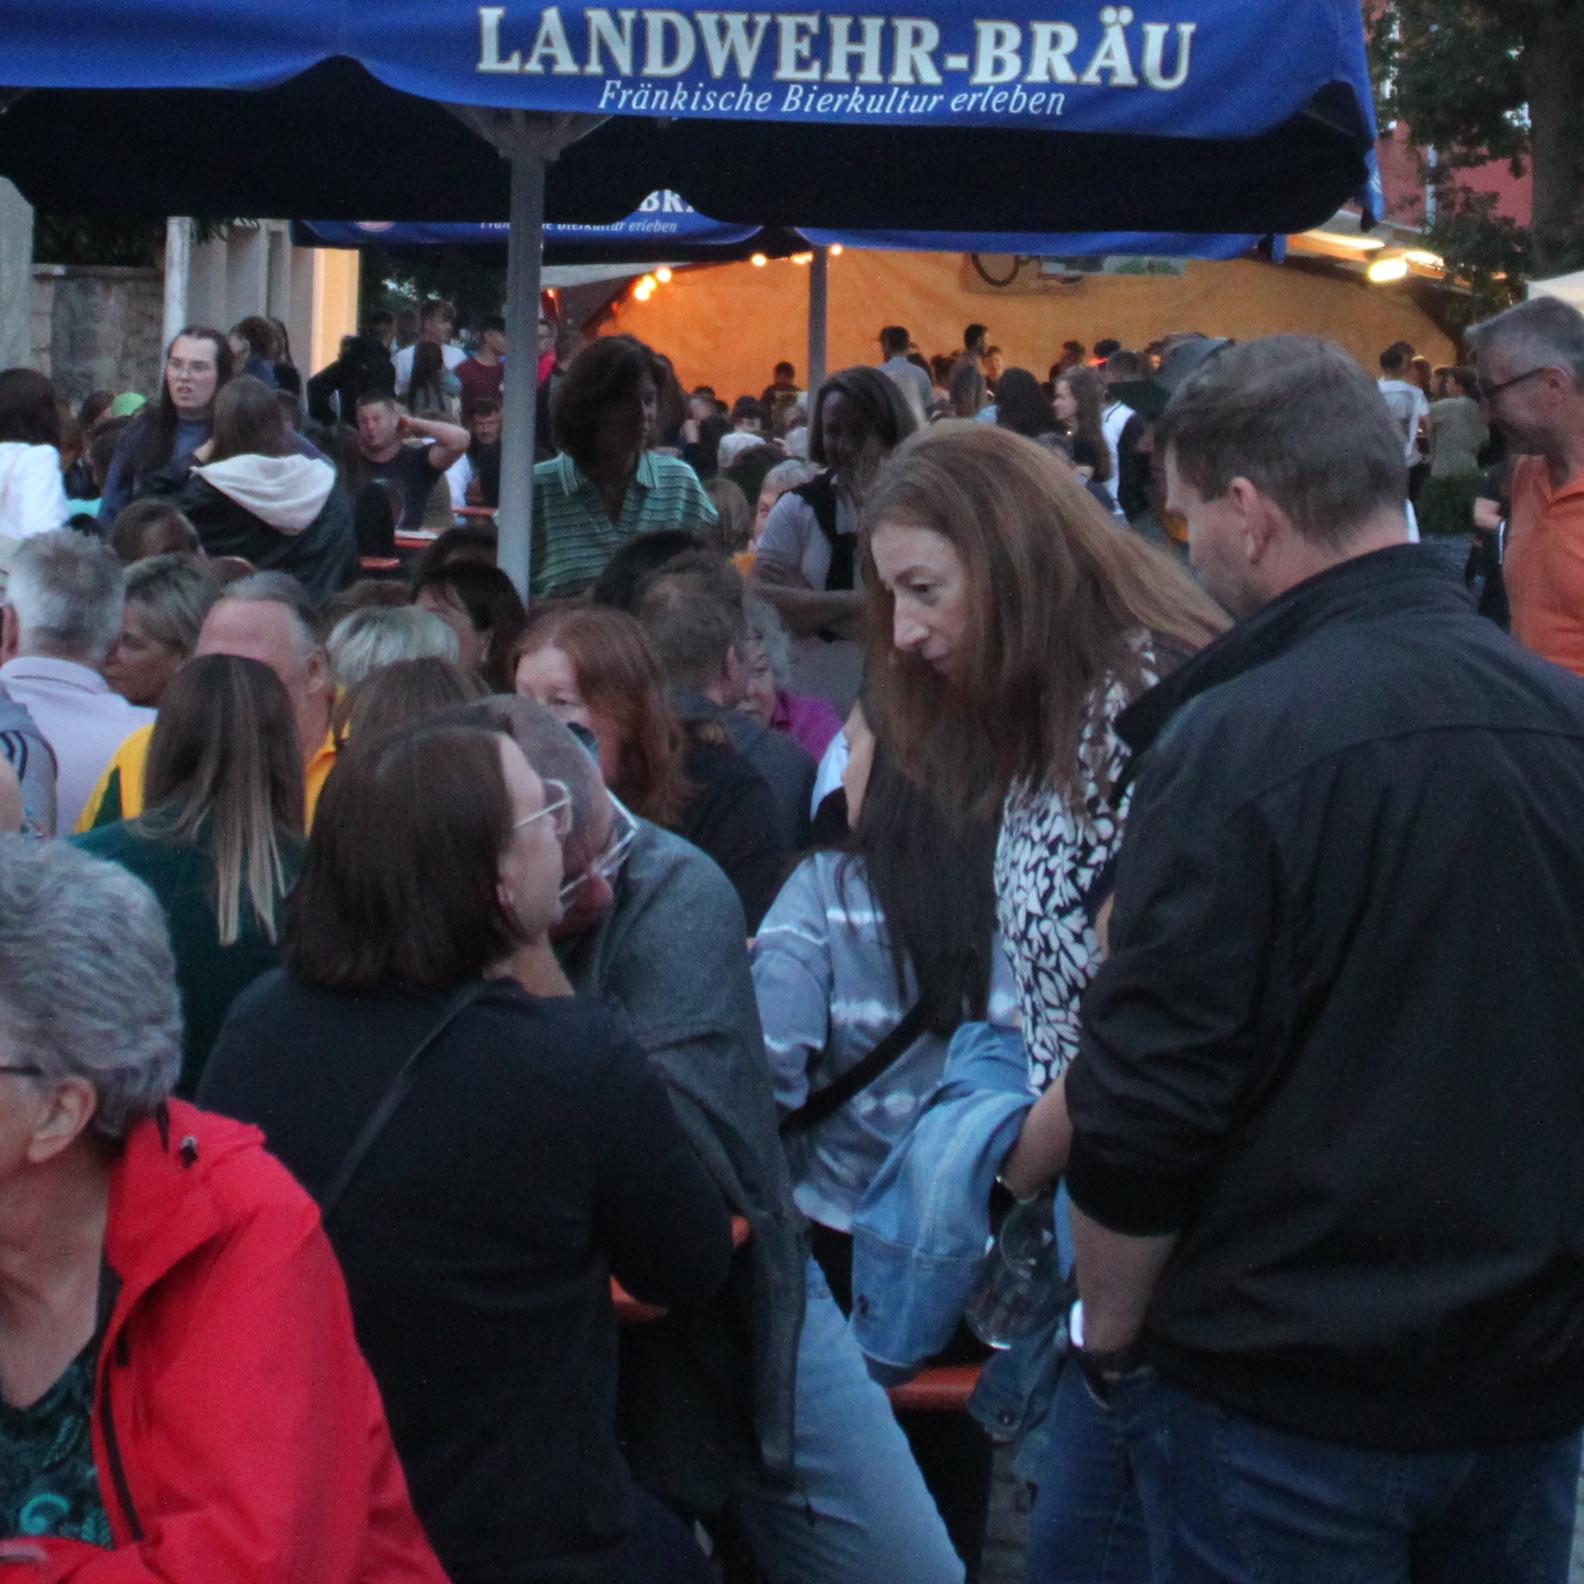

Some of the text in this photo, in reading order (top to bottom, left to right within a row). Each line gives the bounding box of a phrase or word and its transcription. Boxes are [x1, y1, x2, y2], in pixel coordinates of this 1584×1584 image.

[476, 6, 1196, 91] LANDWEHR-BRÄU
[598, 79, 1066, 117] Fränkische Bierkultur erleben
